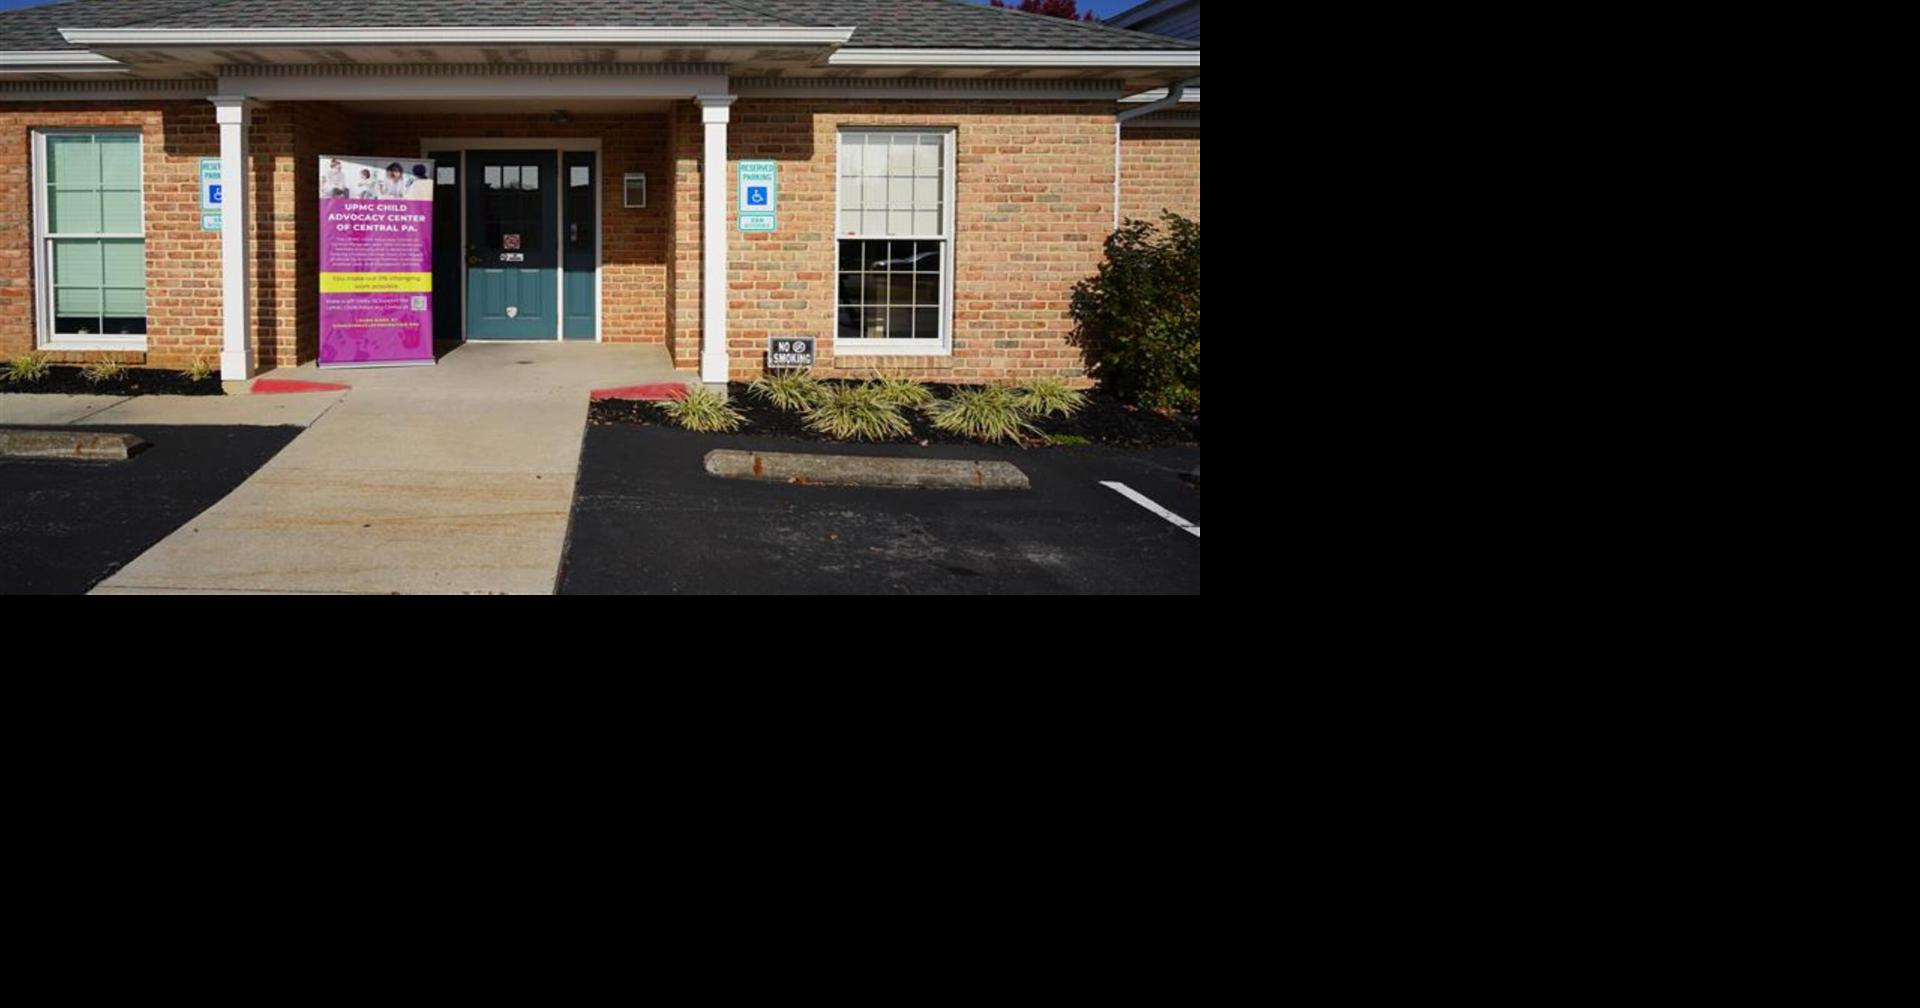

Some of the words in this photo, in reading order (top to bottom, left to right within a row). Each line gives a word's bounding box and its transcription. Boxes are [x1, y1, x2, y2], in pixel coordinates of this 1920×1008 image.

[741, 164, 774, 172] RESERVED
[344, 203, 374, 212] UPMC
[377, 204, 407, 212] CHILD
[328, 213, 385, 221] ADVOCACY
[387, 214, 426, 222] CENTER
[353, 224, 399, 232] CENTRAL
[778, 341, 790, 352] NO
[773, 353, 811, 364] SMOKING
